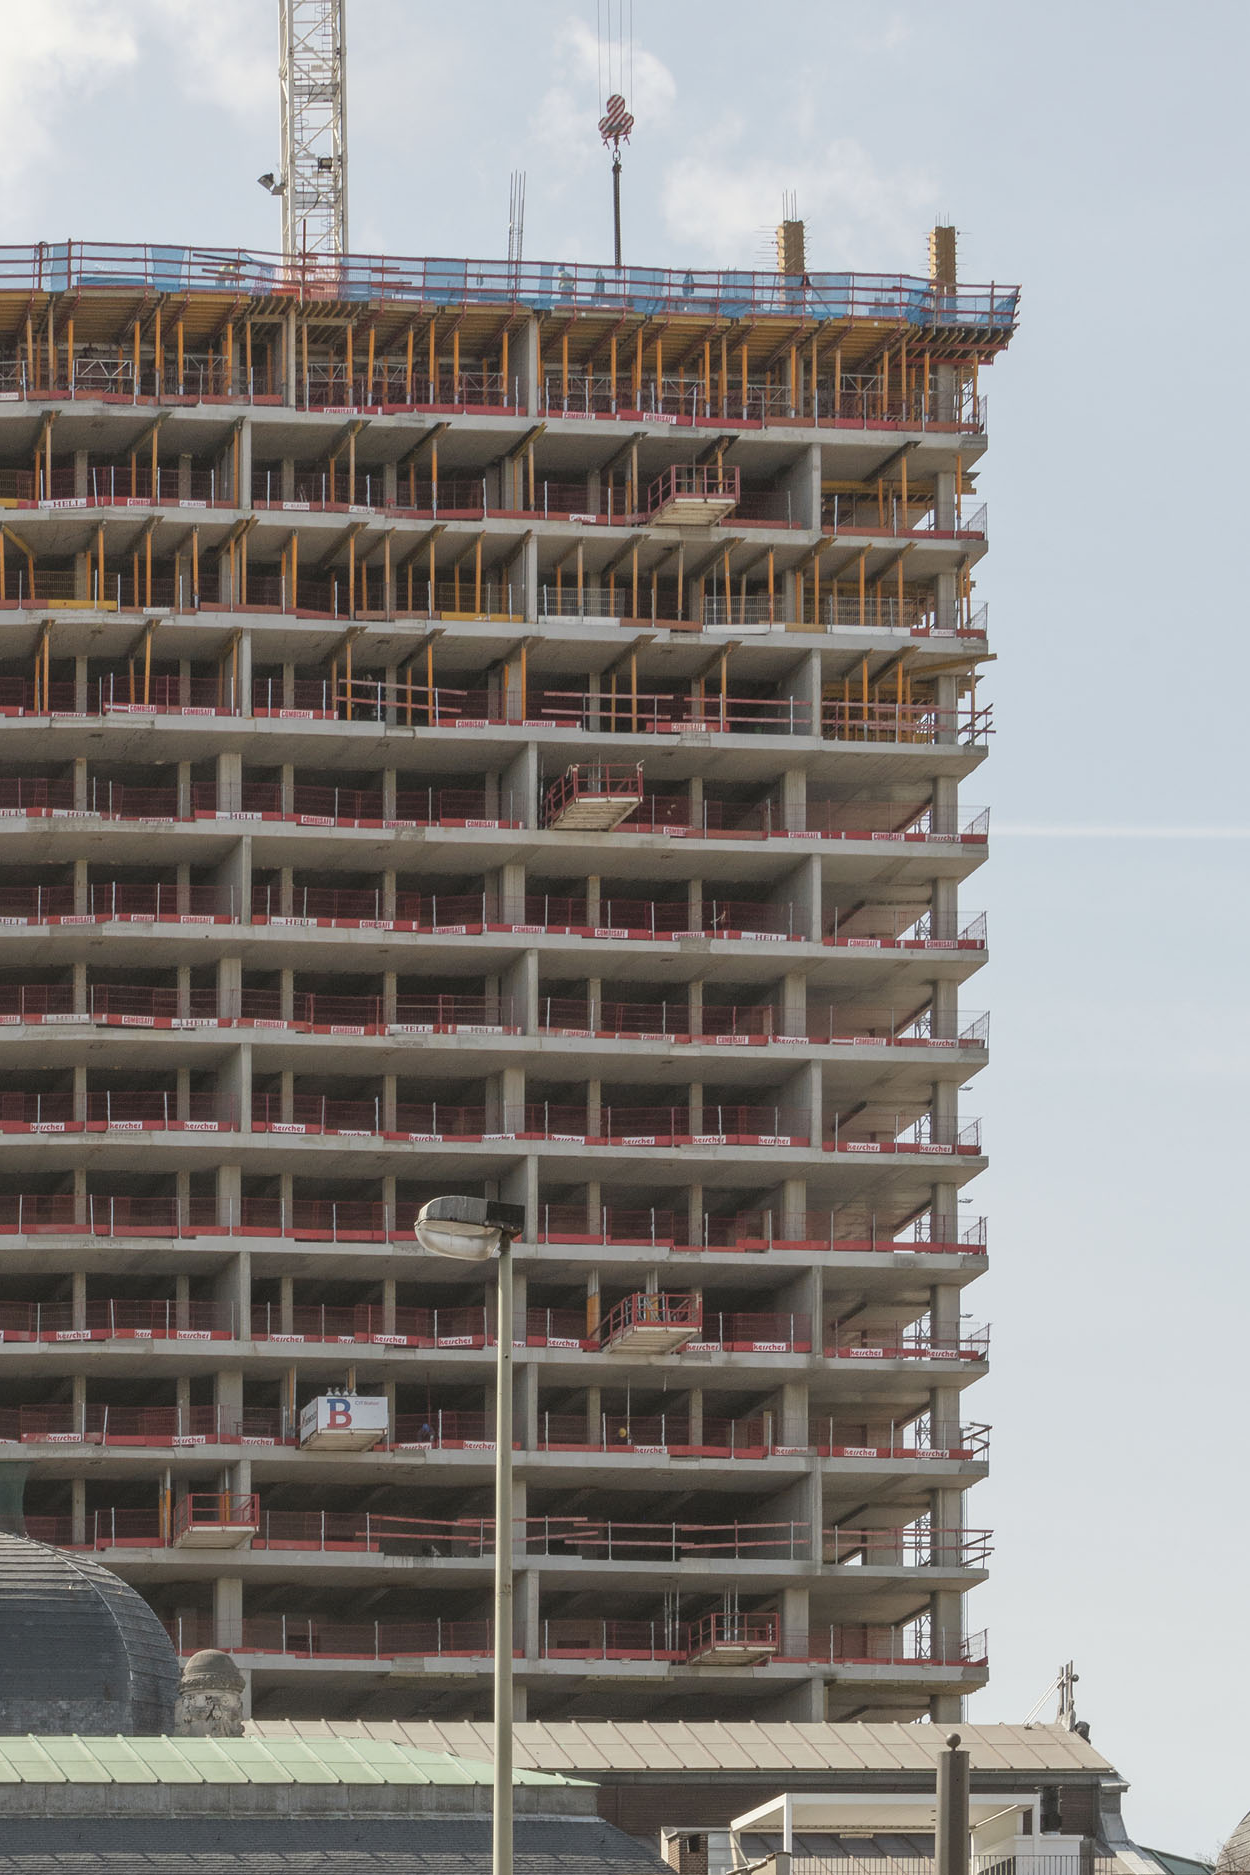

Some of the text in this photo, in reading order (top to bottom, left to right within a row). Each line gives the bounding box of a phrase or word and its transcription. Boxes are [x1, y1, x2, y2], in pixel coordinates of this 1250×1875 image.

[123, 1016, 154, 1024] COMBISAFE
[254, 1020, 287, 1028] COMBISAFE
[110, 1121, 142, 1129] kerscher
[184, 1122, 217, 1130] kerscher
[272, 1124, 305, 1132] kerscher
[177, 1331, 210, 1339] kerscher
[374, 1336, 407, 1344] kerscher
[438, 1336, 472, 1345] kerscher
[687, 1343, 718, 1351] kerscher
[850, 1348, 883, 1356] kerscher
[327, 1399, 352, 1427] B
[47, 1433, 81, 1441] kerscher
[241, 1438, 274, 1446] kerscher
[463, 1441, 495, 1449] kerscher
[844, 1449, 877, 1457] kerscher
